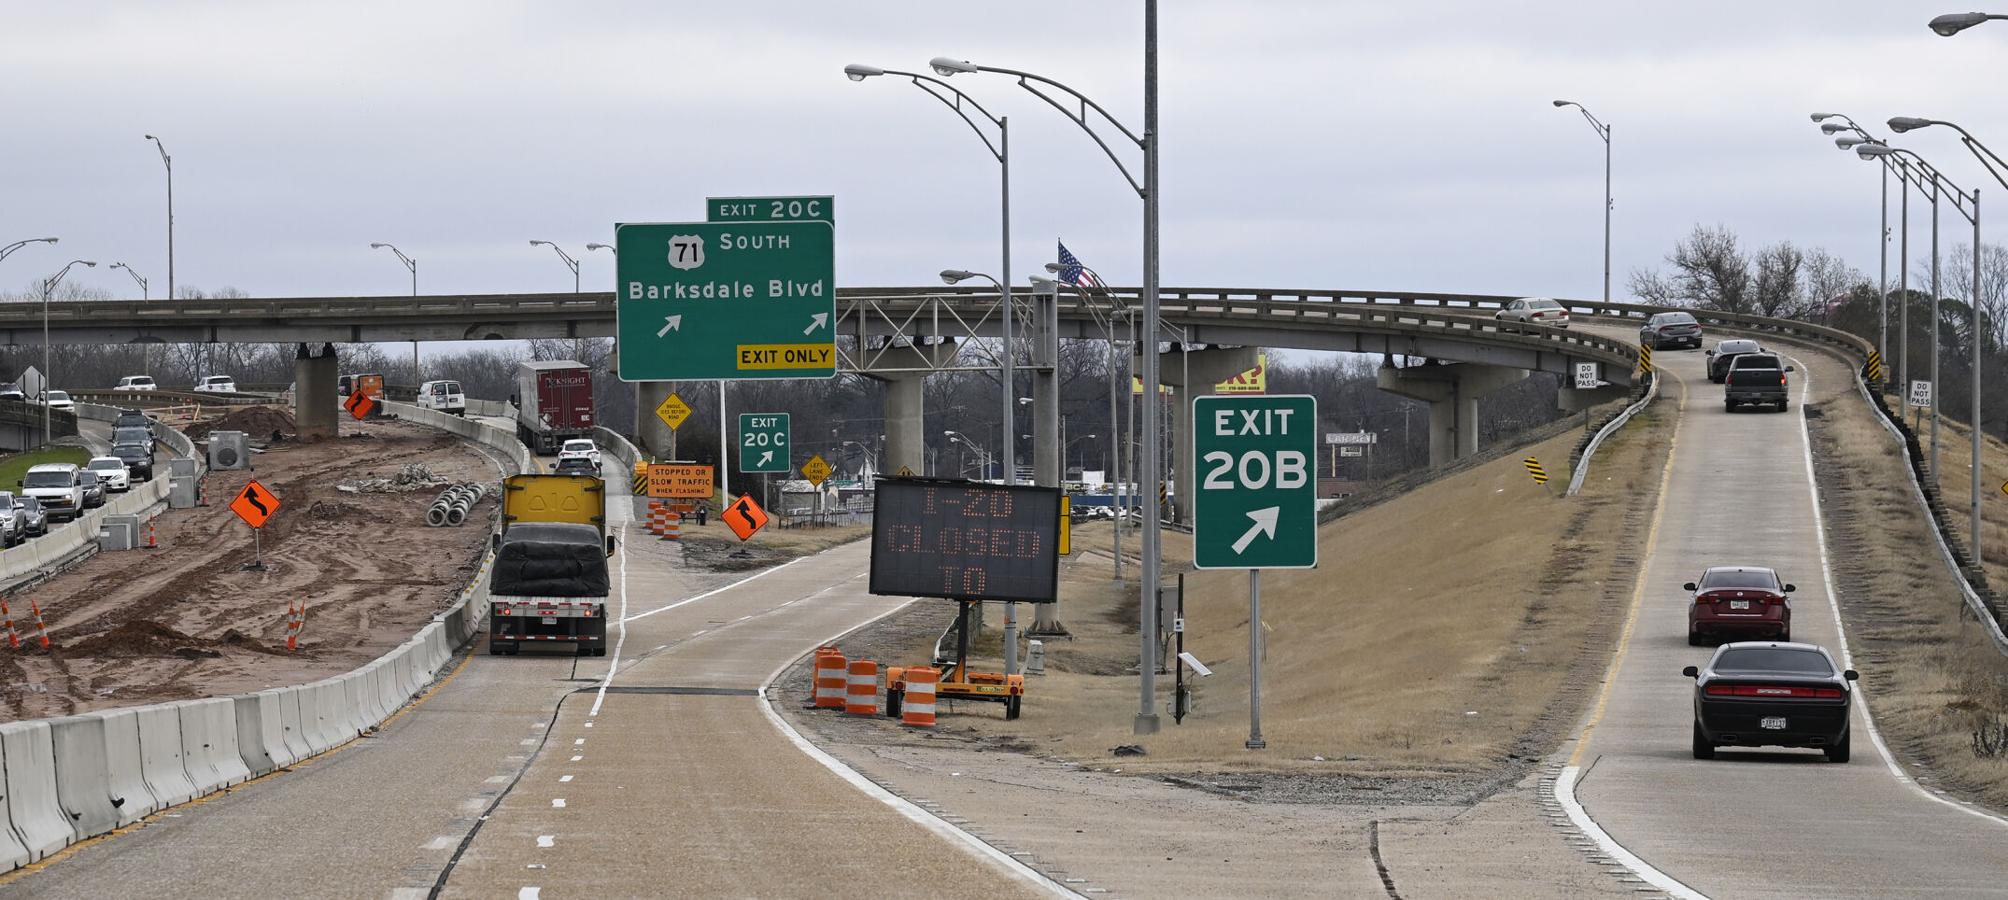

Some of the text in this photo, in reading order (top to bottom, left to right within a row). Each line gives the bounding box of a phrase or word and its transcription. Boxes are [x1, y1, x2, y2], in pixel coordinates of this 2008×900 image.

[720, 200, 821, 218] EXIT 20C
[674, 243, 698, 262] 71
[629, 279, 823, 299] Barksdale Blvd
[741, 349, 829, 363] EXIT ONLY
[751, 418, 778, 428] EXIT
[1216, 409, 1294, 435] EXIT
[744, 432, 784, 447] 20 C
[1203, 450, 1307, 490] 20B
[923, 487, 1014, 518] I-20
[888, 524, 1041, 559] CLOSED
[938, 566, 986, 595] TO
